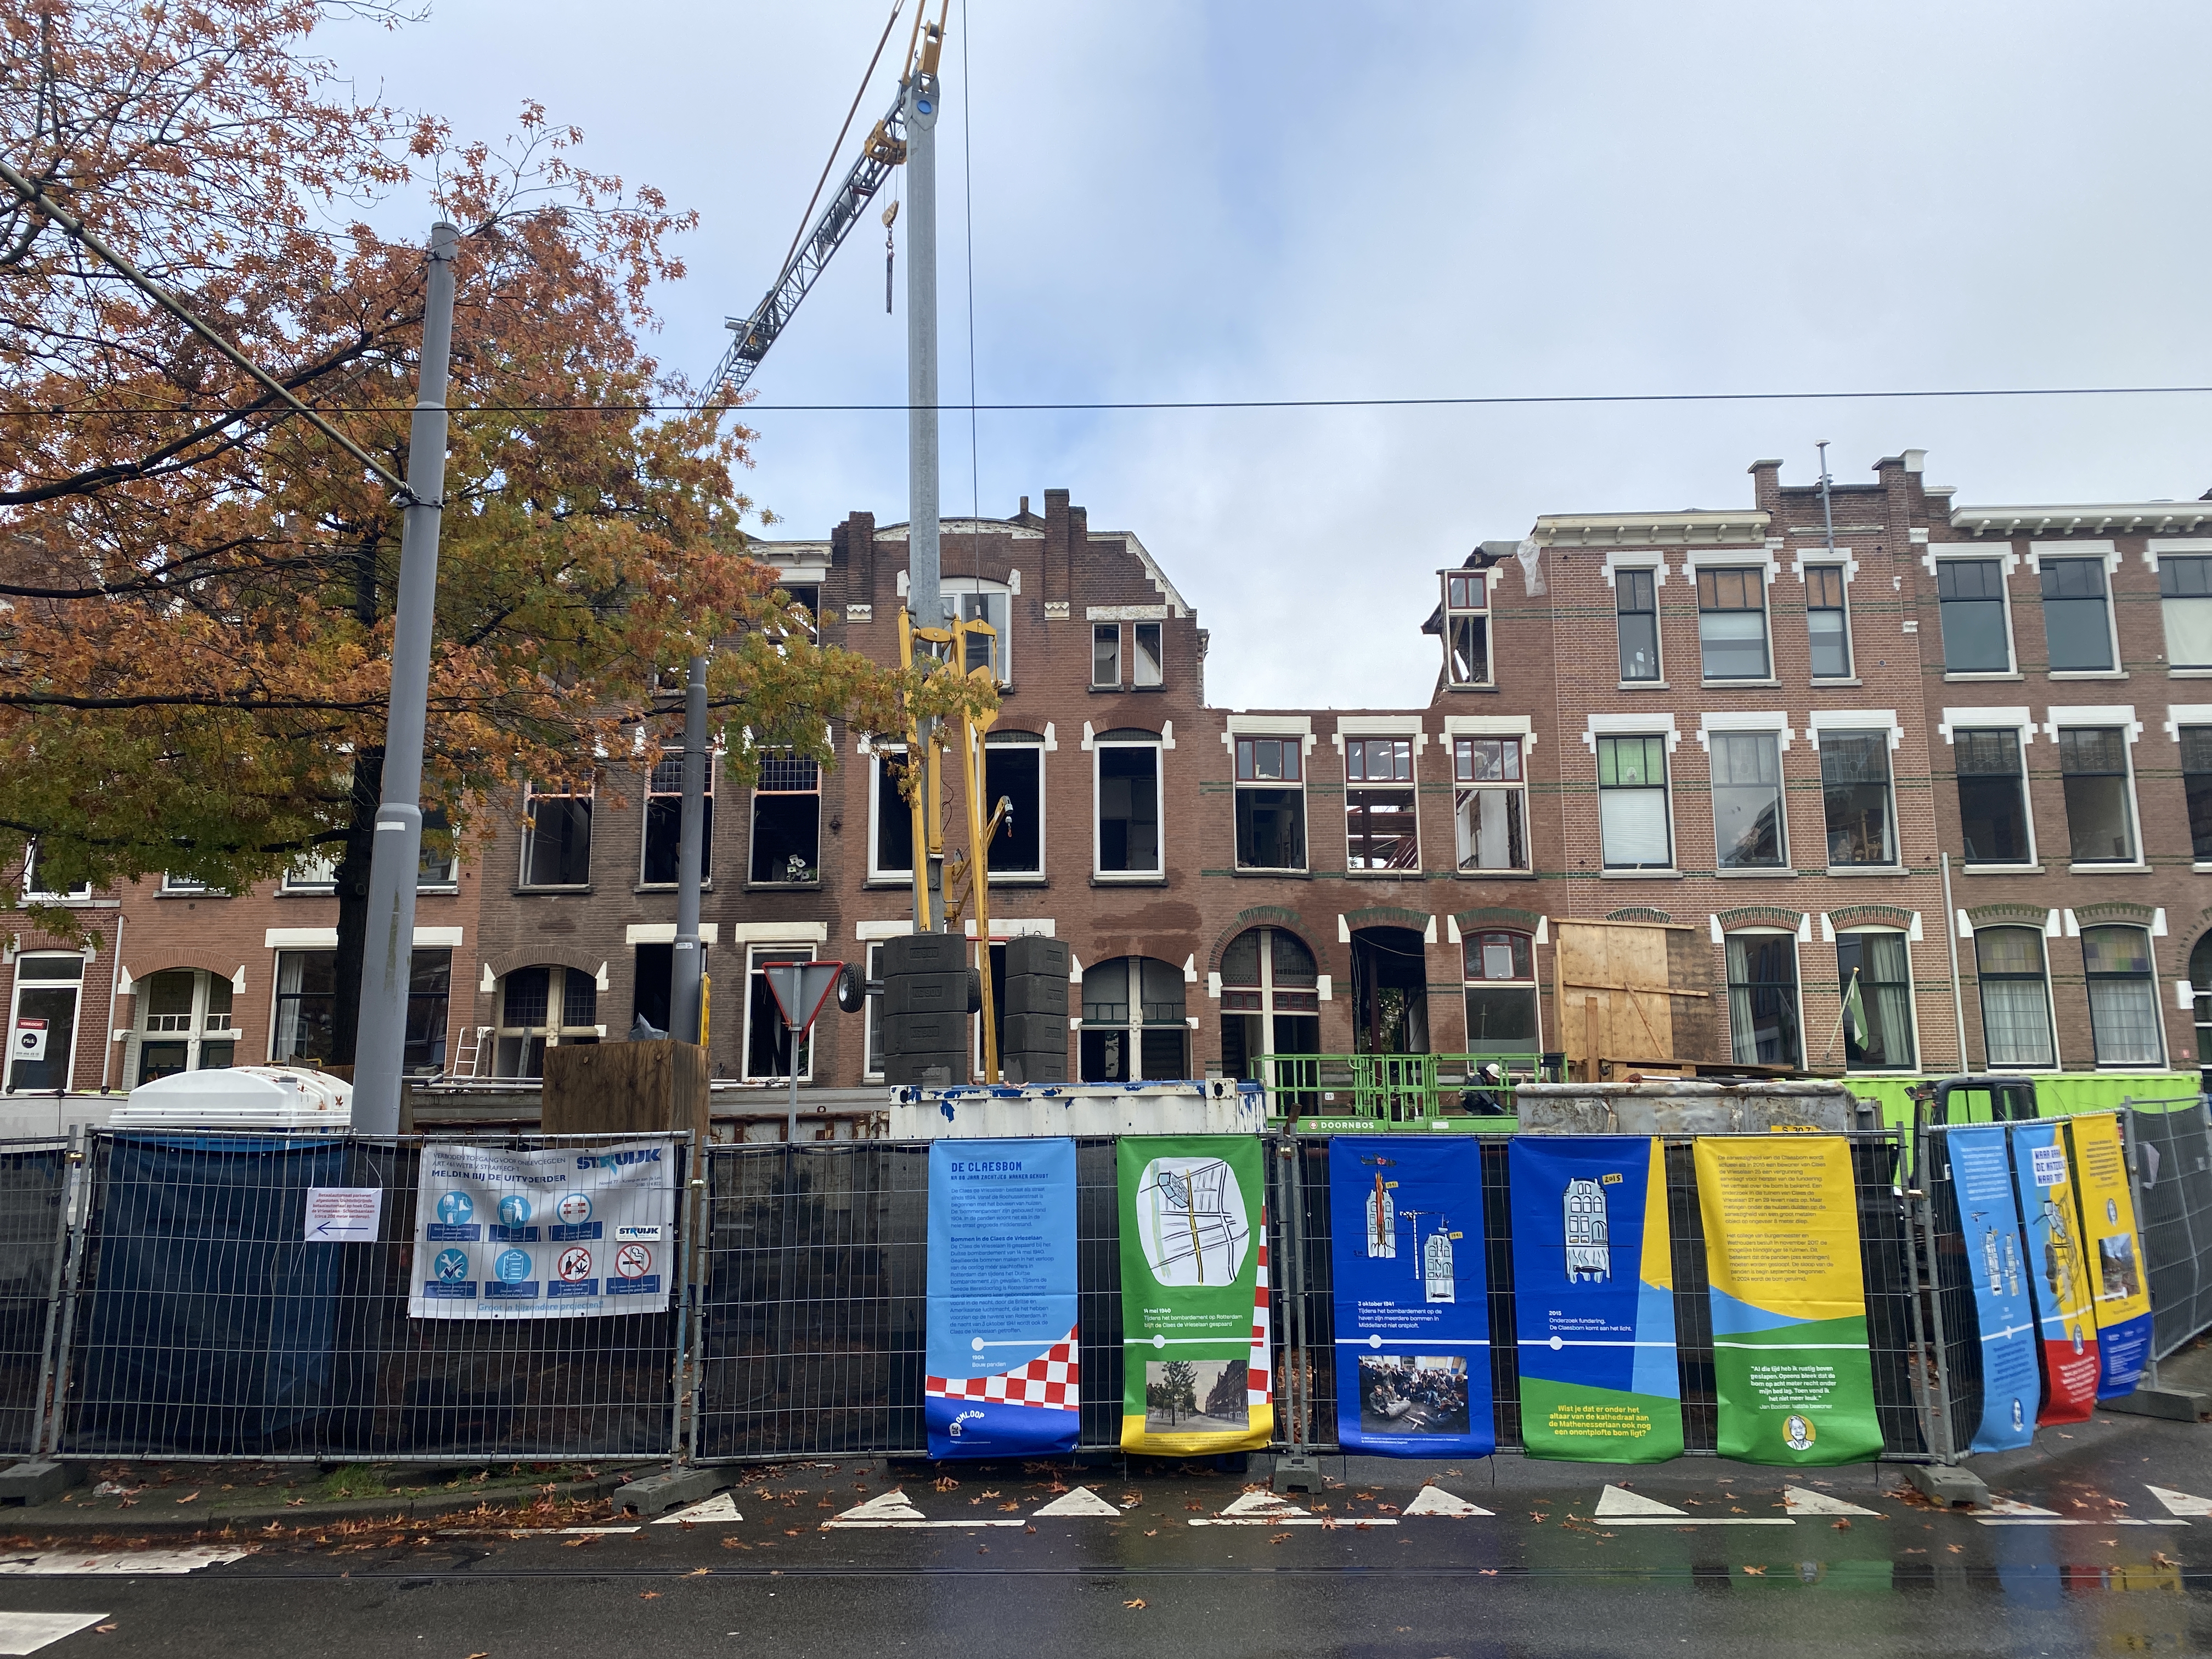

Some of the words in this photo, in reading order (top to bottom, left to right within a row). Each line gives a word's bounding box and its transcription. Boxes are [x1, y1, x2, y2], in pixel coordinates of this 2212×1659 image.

[925, 988, 941, 997] 900
[466, 1155, 499, 1163] TOEGANG
[577, 1148, 662, 1176] STRUIJK
[952, 1163, 964, 1172] DE
[968, 1161, 1022, 1172] CLAESBOM
[619, 1228, 658, 1238] STRUIJK
[956, 1410, 985, 1424] OMLOOP
[952, 1425, 958, 1434] DE
